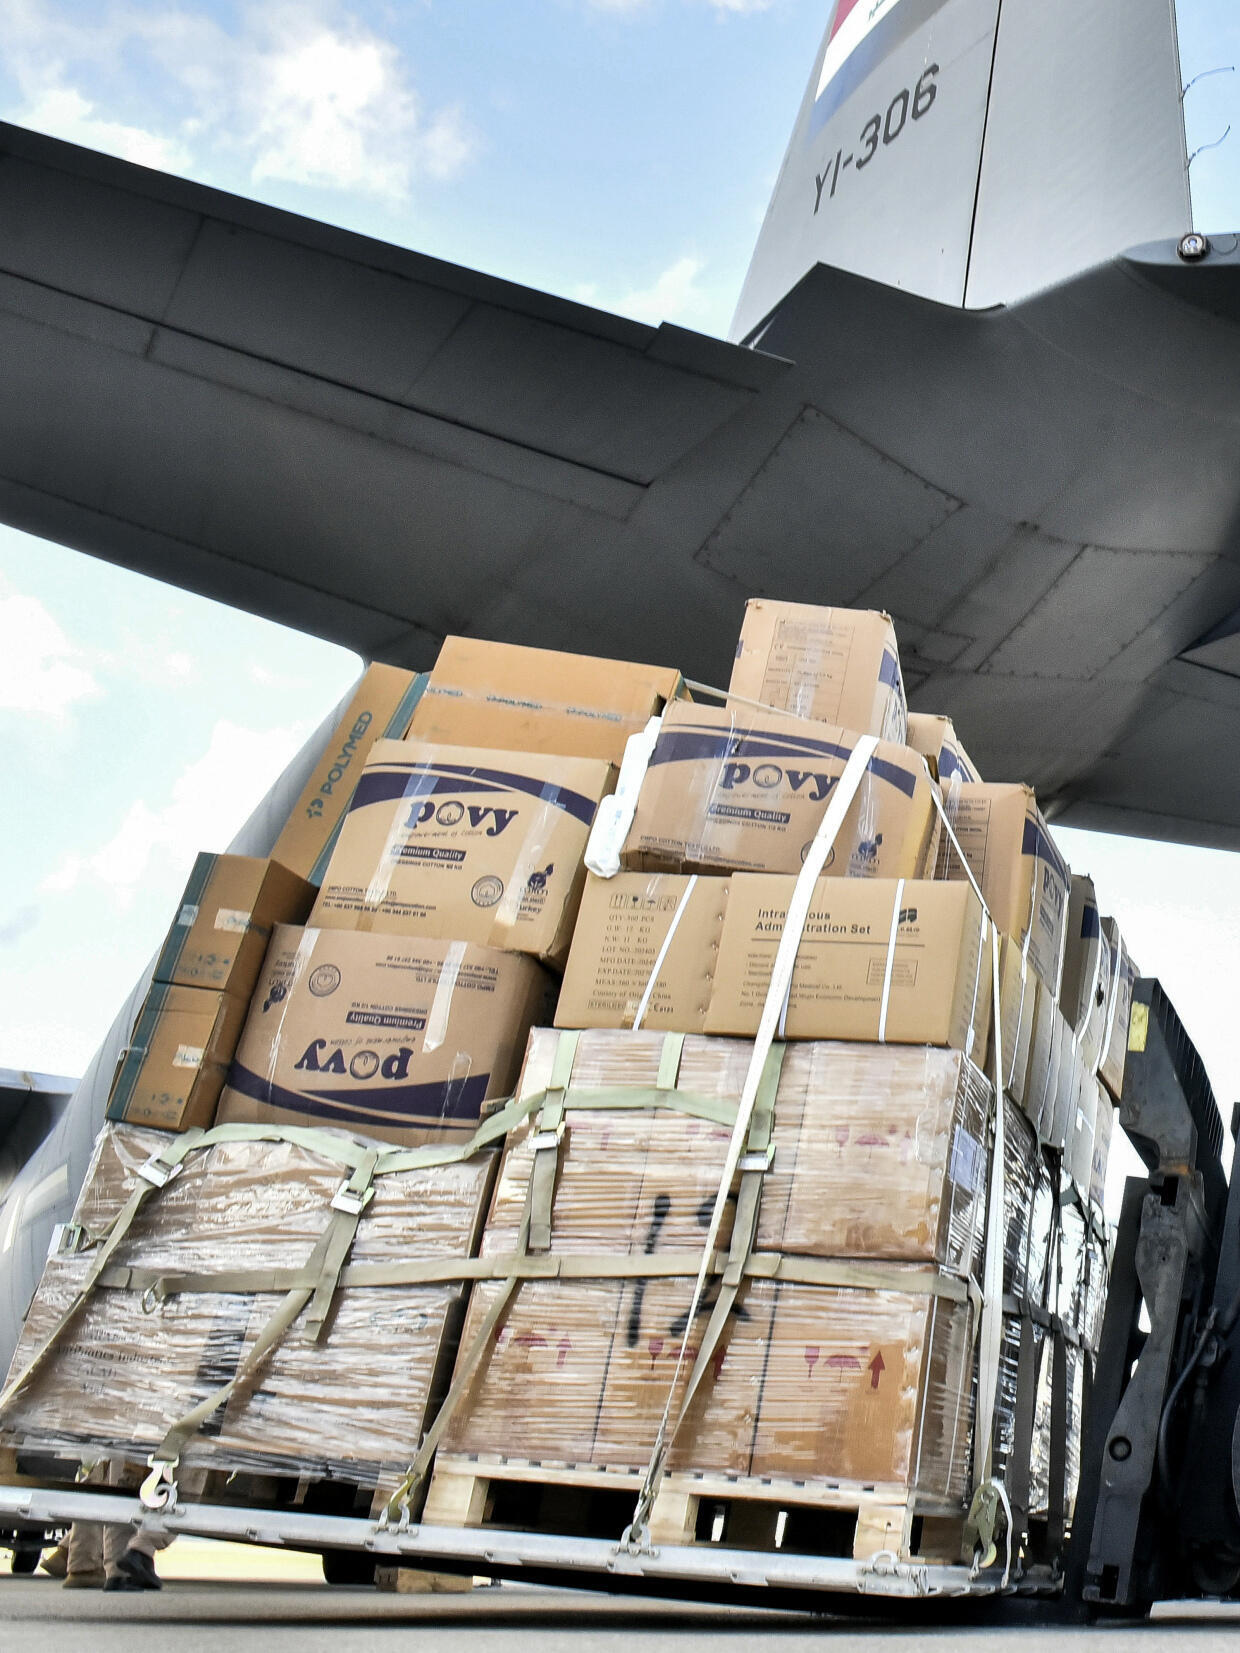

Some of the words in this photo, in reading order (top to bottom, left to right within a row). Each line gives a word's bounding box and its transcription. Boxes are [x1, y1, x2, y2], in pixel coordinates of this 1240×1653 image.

[813, 62, 940, 215] YI-306
[320, 710, 373, 795] POLYMED
[719, 762, 840, 802] povy
[404, 800, 519, 837] povy
[711, 804, 752, 817] Premium
[754, 809, 787, 823] Quality
[392, 845, 431, 858] Premium
[432, 848, 463, 861] Quality
[758, 908, 831, 920] Intraous
[755, 922, 847, 934] Admtration
[850, 923, 871, 935] Set
[350, 1012, 381, 1026] Quality
[384, 1015, 422, 1030] Premium
[293, 1038, 414, 1081] povy
